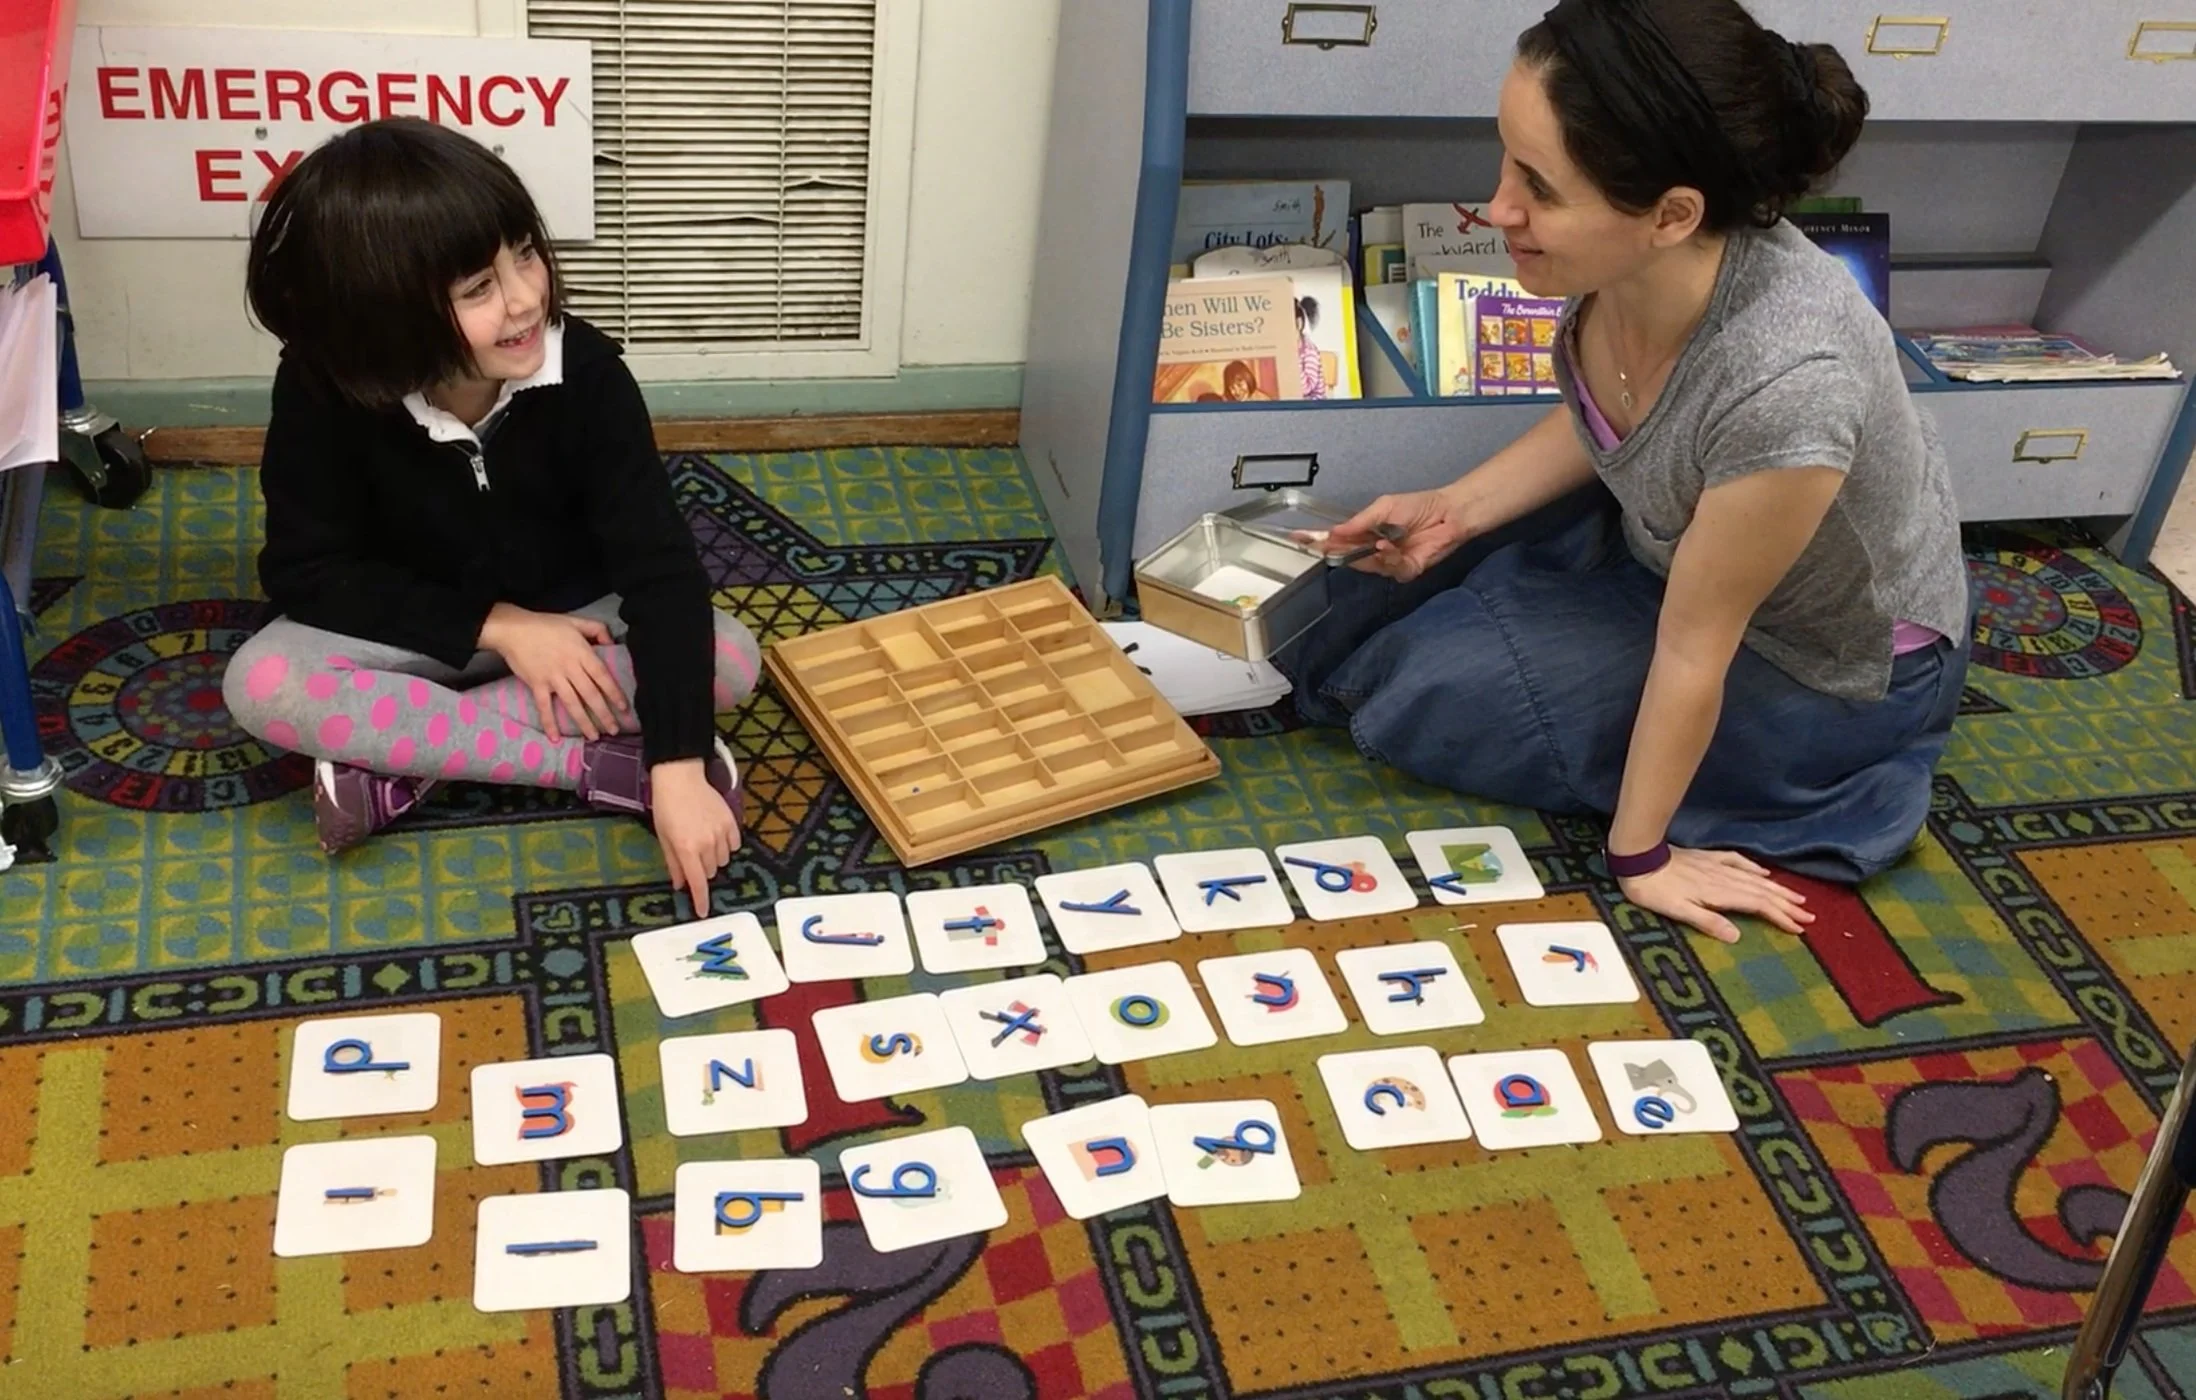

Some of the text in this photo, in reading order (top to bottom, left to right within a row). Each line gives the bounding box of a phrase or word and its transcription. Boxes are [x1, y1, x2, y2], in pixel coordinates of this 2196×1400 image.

[97, 67, 570, 127] EMERGENCY
[196, 149, 301, 202] EX
[1418, 222, 1444, 239] The
[1202, 296, 1239, 315] Will
[1244, 295, 1272, 312] We
[1160, 316, 1265, 339] Be Sisters?
